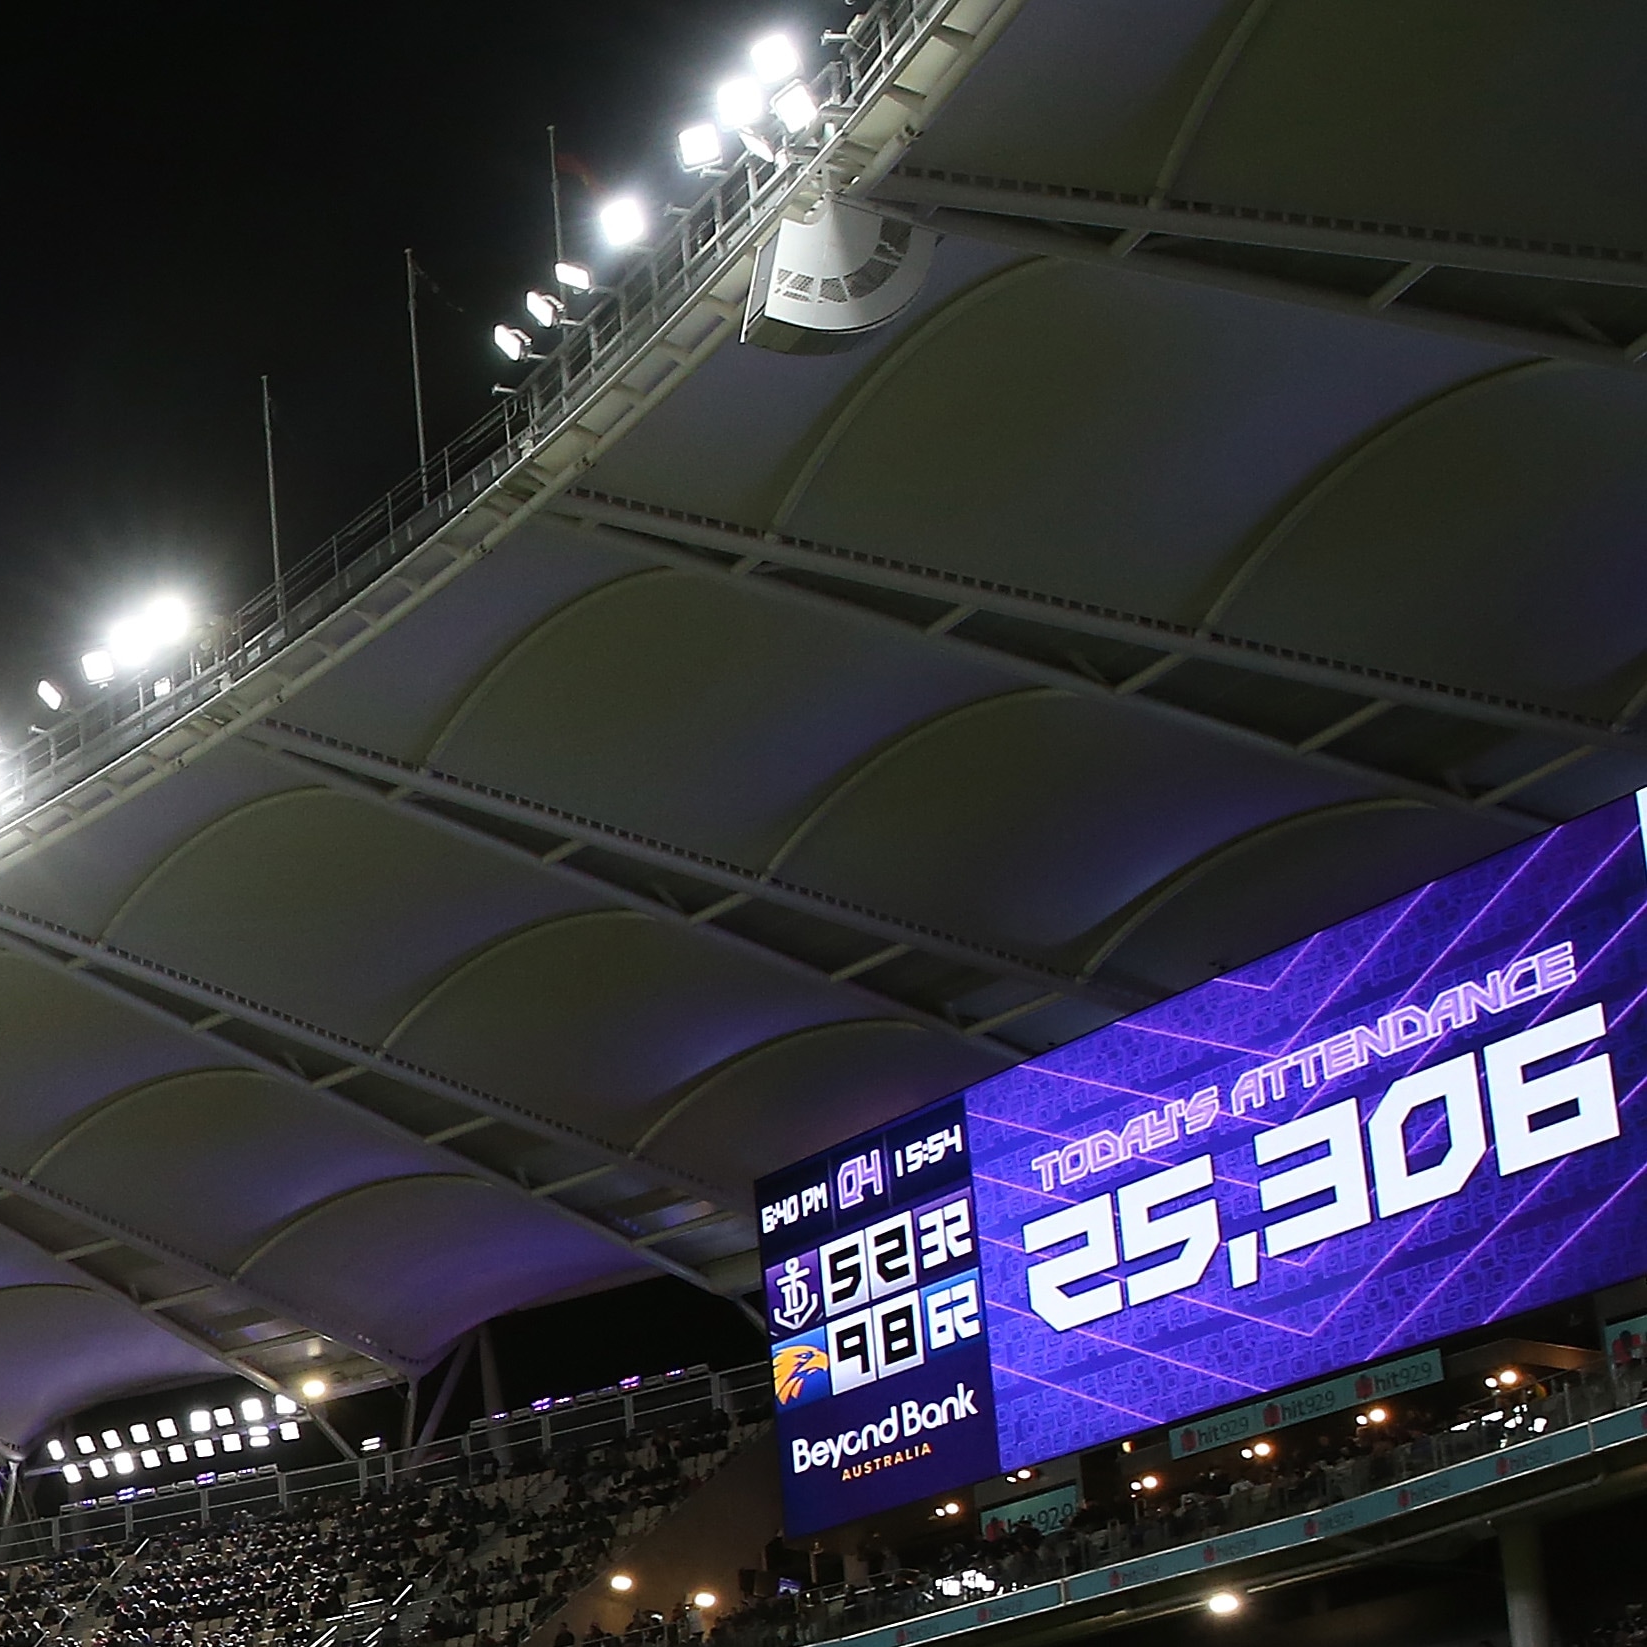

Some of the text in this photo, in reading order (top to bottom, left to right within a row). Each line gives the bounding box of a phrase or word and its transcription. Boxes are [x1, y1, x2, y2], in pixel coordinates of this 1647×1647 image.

[1031, 941, 1578, 1192] TODAY'S ATTENDANCE
[895, 1124, 963, 1177] 15:54
[1022, 1002, 1621, 1331] 25,306
[837, 1149, 883, 1209] Q4
[762, 1182, 828, 1233] 6:40 PM
[918, 1199, 973, 1270] 32
[927, 1279, 981, 1350] 62
[1279, 1389, 1336, 1420] hit929
[1374, 1362, 1432, 1393] hit929
[792, 1383, 979, 1474] Beyond Bank
[1197, 1416, 1249, 1443] hit929
[842, 1442, 933, 1481] AUSTRALIA
